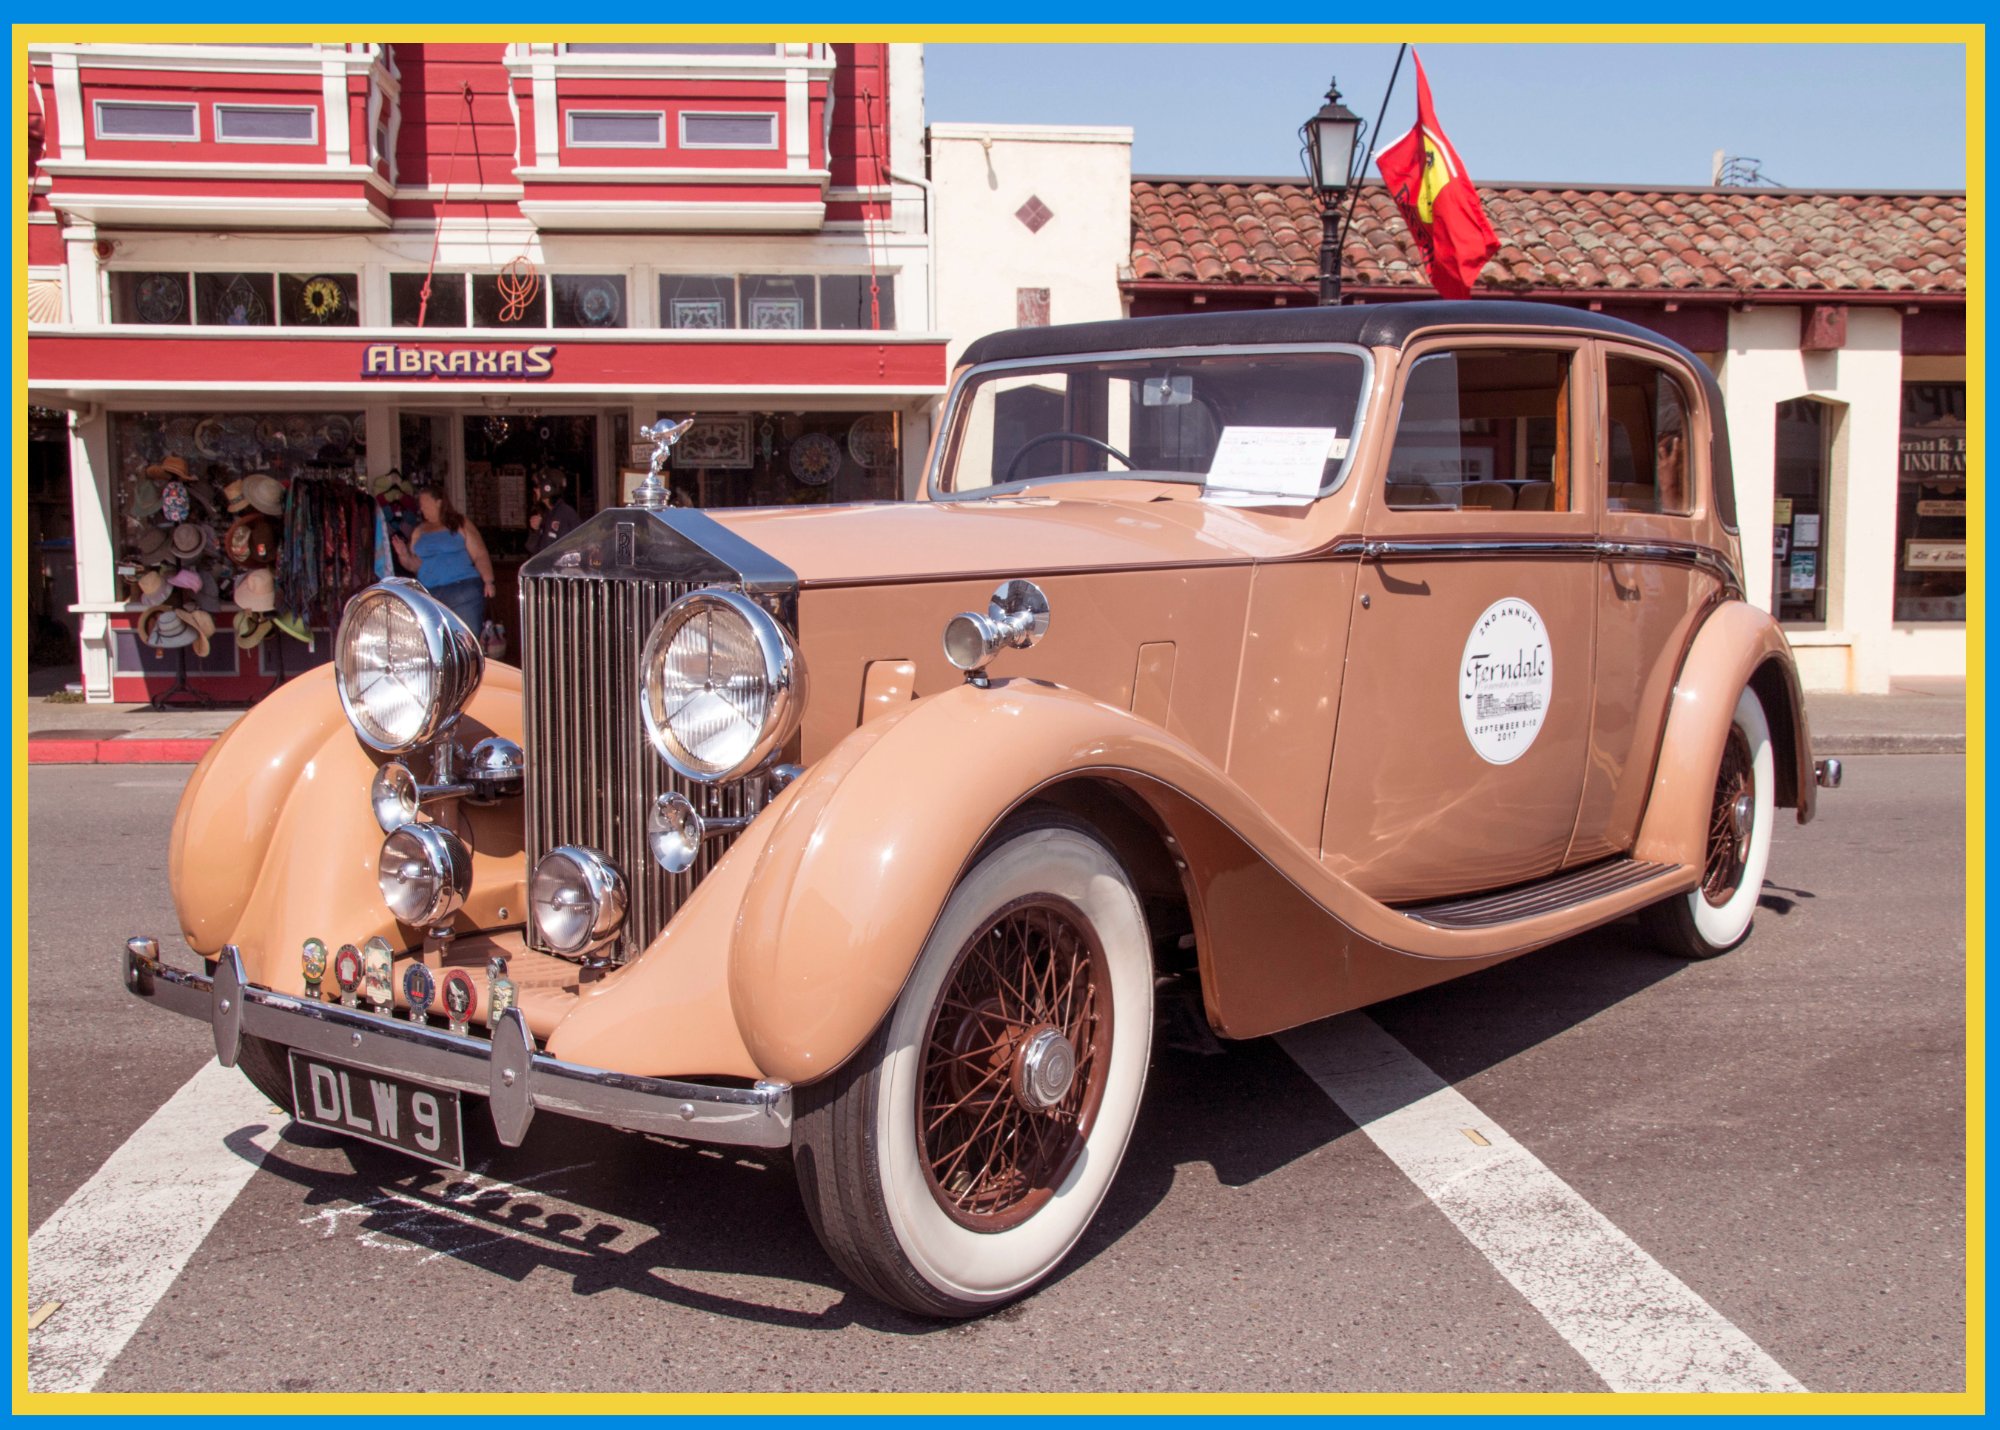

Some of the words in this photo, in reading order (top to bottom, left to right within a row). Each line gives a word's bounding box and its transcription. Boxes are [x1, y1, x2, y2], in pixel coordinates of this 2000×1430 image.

[363, 345, 556, 377] ABRAXAS
[1899, 441, 1935, 451] erald
[1479, 613, 1497, 637] 2ND
[1501, 607, 1537, 631] ANNUAL
[1465, 643, 1545, 700] Ferndale
[1474, 721, 1520, 735] SEPTEMBER
[1497, 731, 1517, 742] 2017
[309, 1063, 398, 1140] DLW
[411, 1091, 441, 1151] 9
